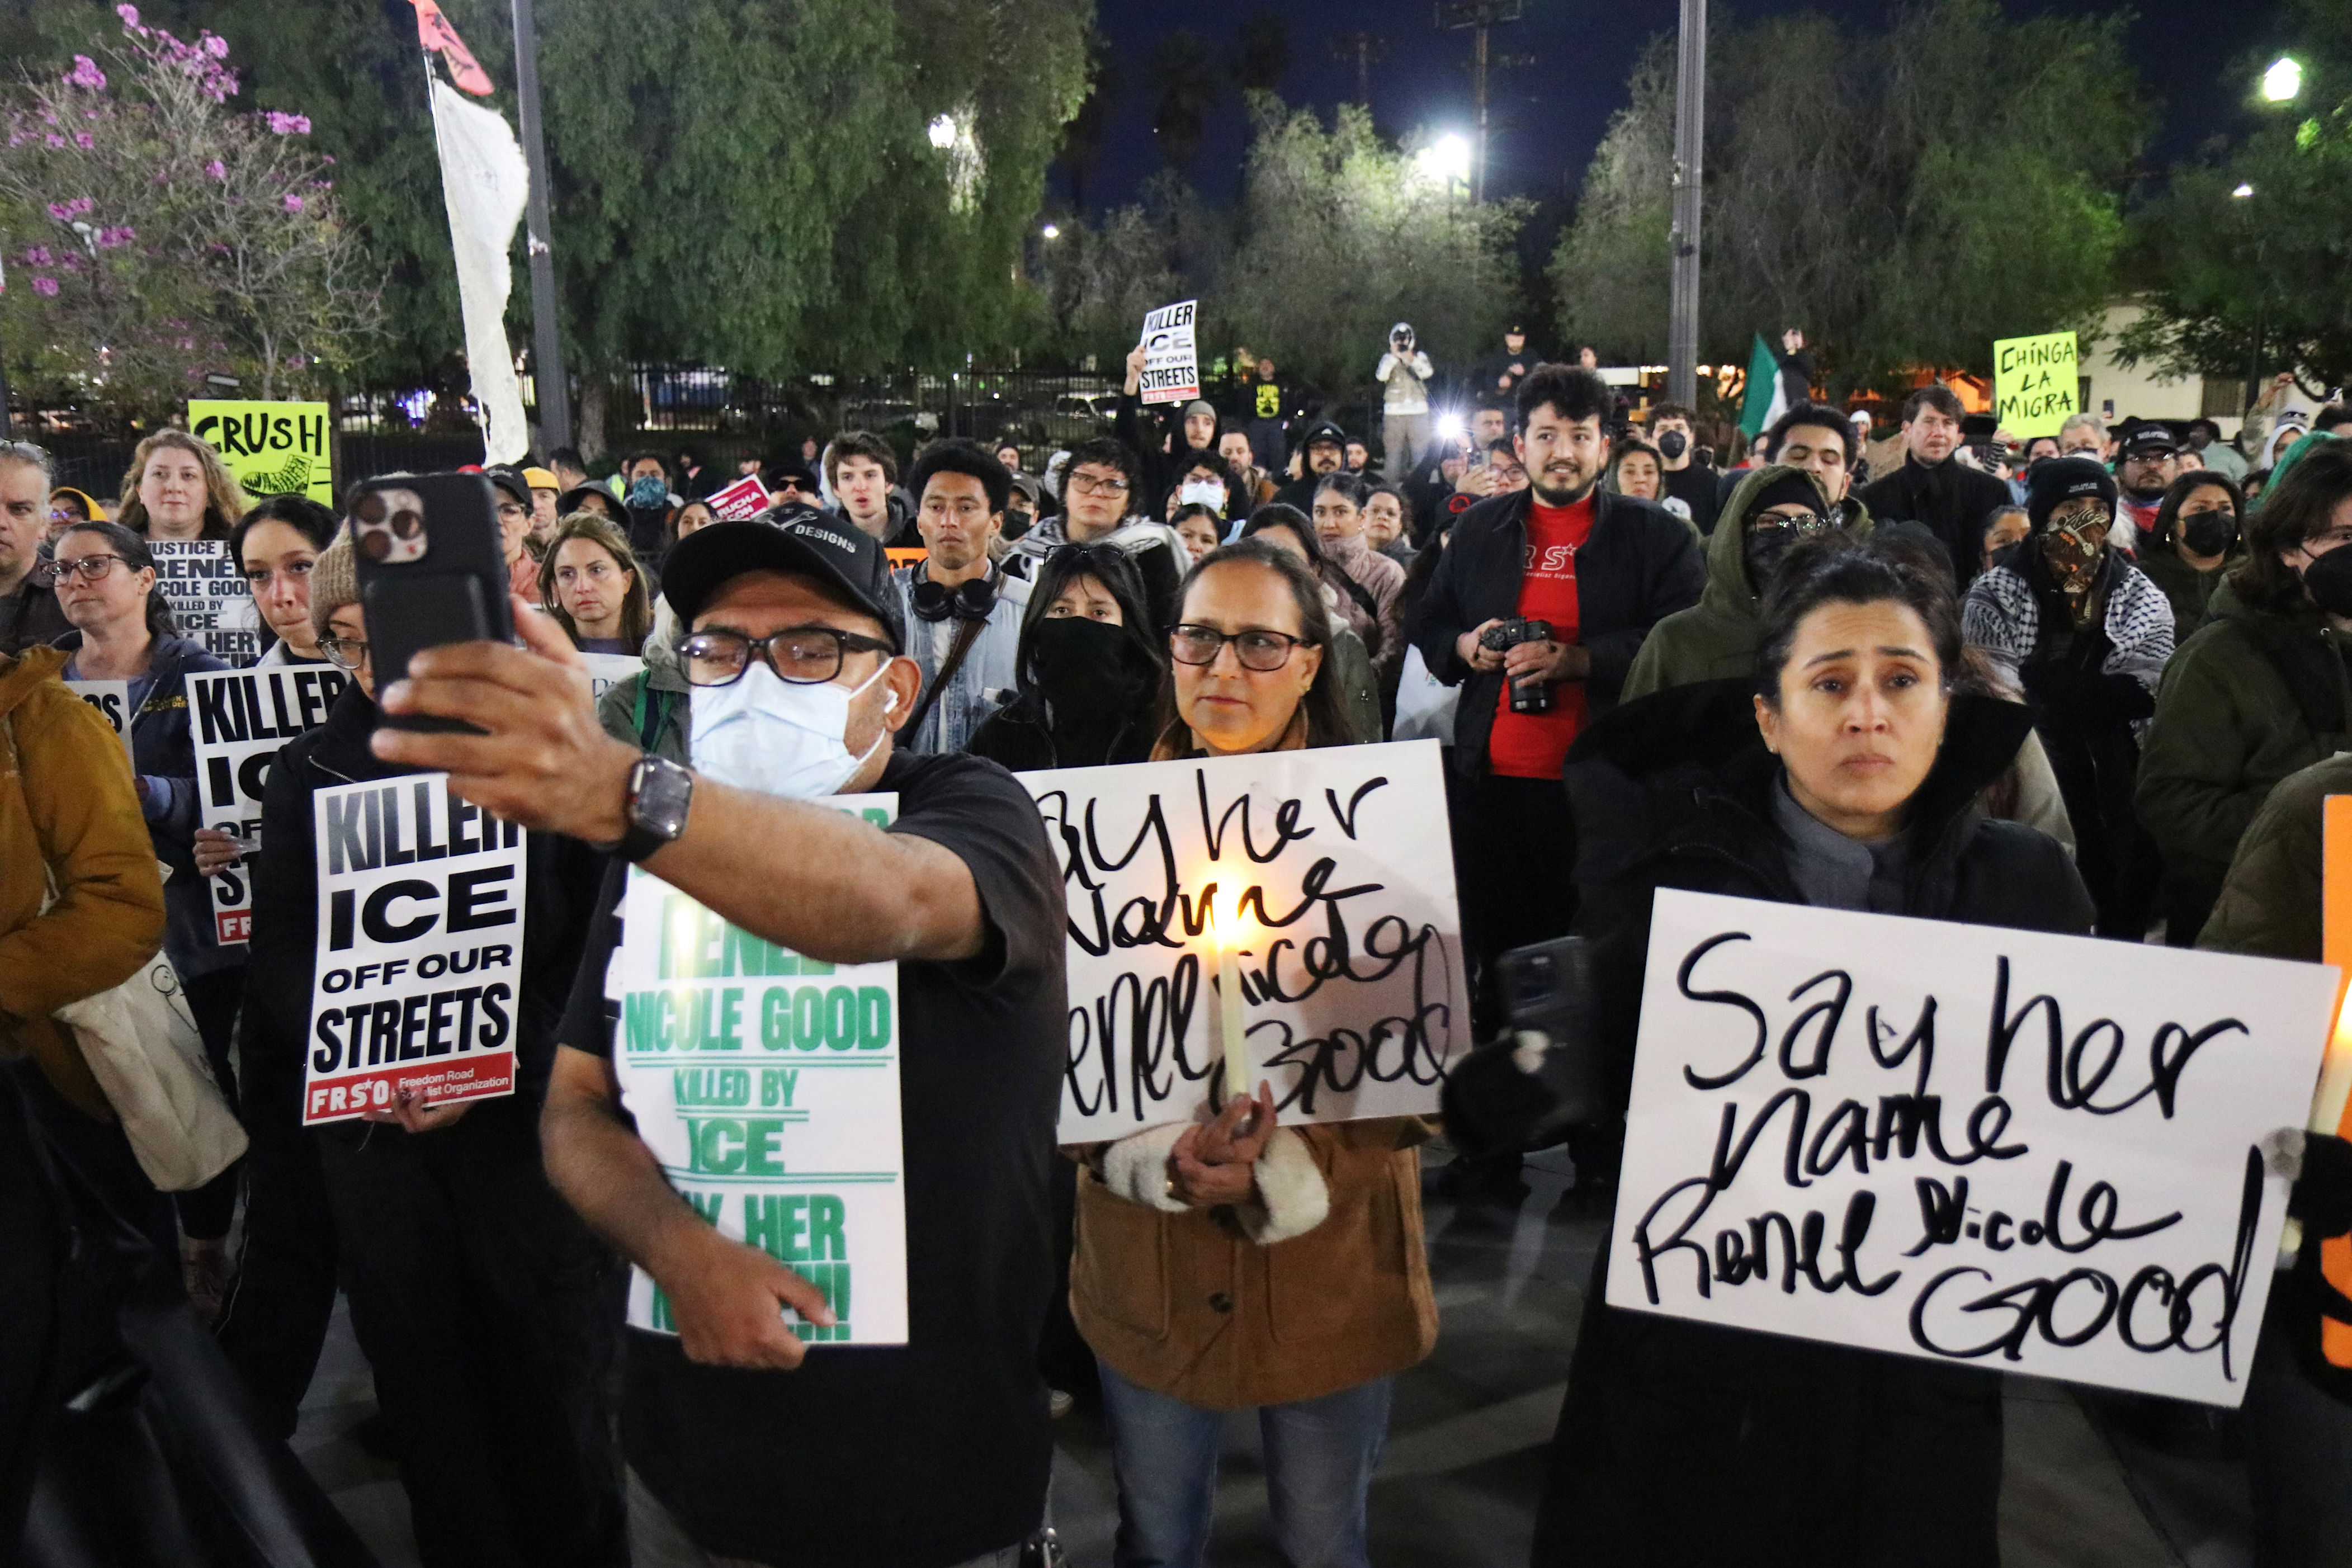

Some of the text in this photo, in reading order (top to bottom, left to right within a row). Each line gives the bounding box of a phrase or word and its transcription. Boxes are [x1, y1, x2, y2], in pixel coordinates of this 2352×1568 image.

[1147, 305, 1193, 333] KILLER
[1142, 366, 1195, 389] STREETS
[2021, 371, 2051, 391] LA
[1999, 390, 2072, 423] MIGRA
[194, 413, 323, 456] CRUSH
[149, 542, 215, 555] USTICE
[795, 525, 856, 553] DESIGNS
[155, 559, 247, 578] RENE
[157, 581, 201, 596] COLE
[169, 600, 223, 611] KILLED BY
[176, 614, 219, 630] ICE
[205, 632, 254, 652] HER
[1036, 768, 1388, 931] ay her
[330, 864, 516, 951] ICE
[659, 895, 835, 979] REN
[322, 944, 512, 993] OFF OUR
[313, 983, 511, 1073] STREETS
[625, 985, 891, 1052] NICOLE GOOD
[1678, 932, 2249, 1119] Say her
[399, 1068, 474, 1087] Freedom Road
[444, 1077, 509, 1094] Organization
[674, 1069, 799, 1107] KILLED BY
[687, 1118, 784, 1175] ICE
[745, 1194, 847, 1260] HER
